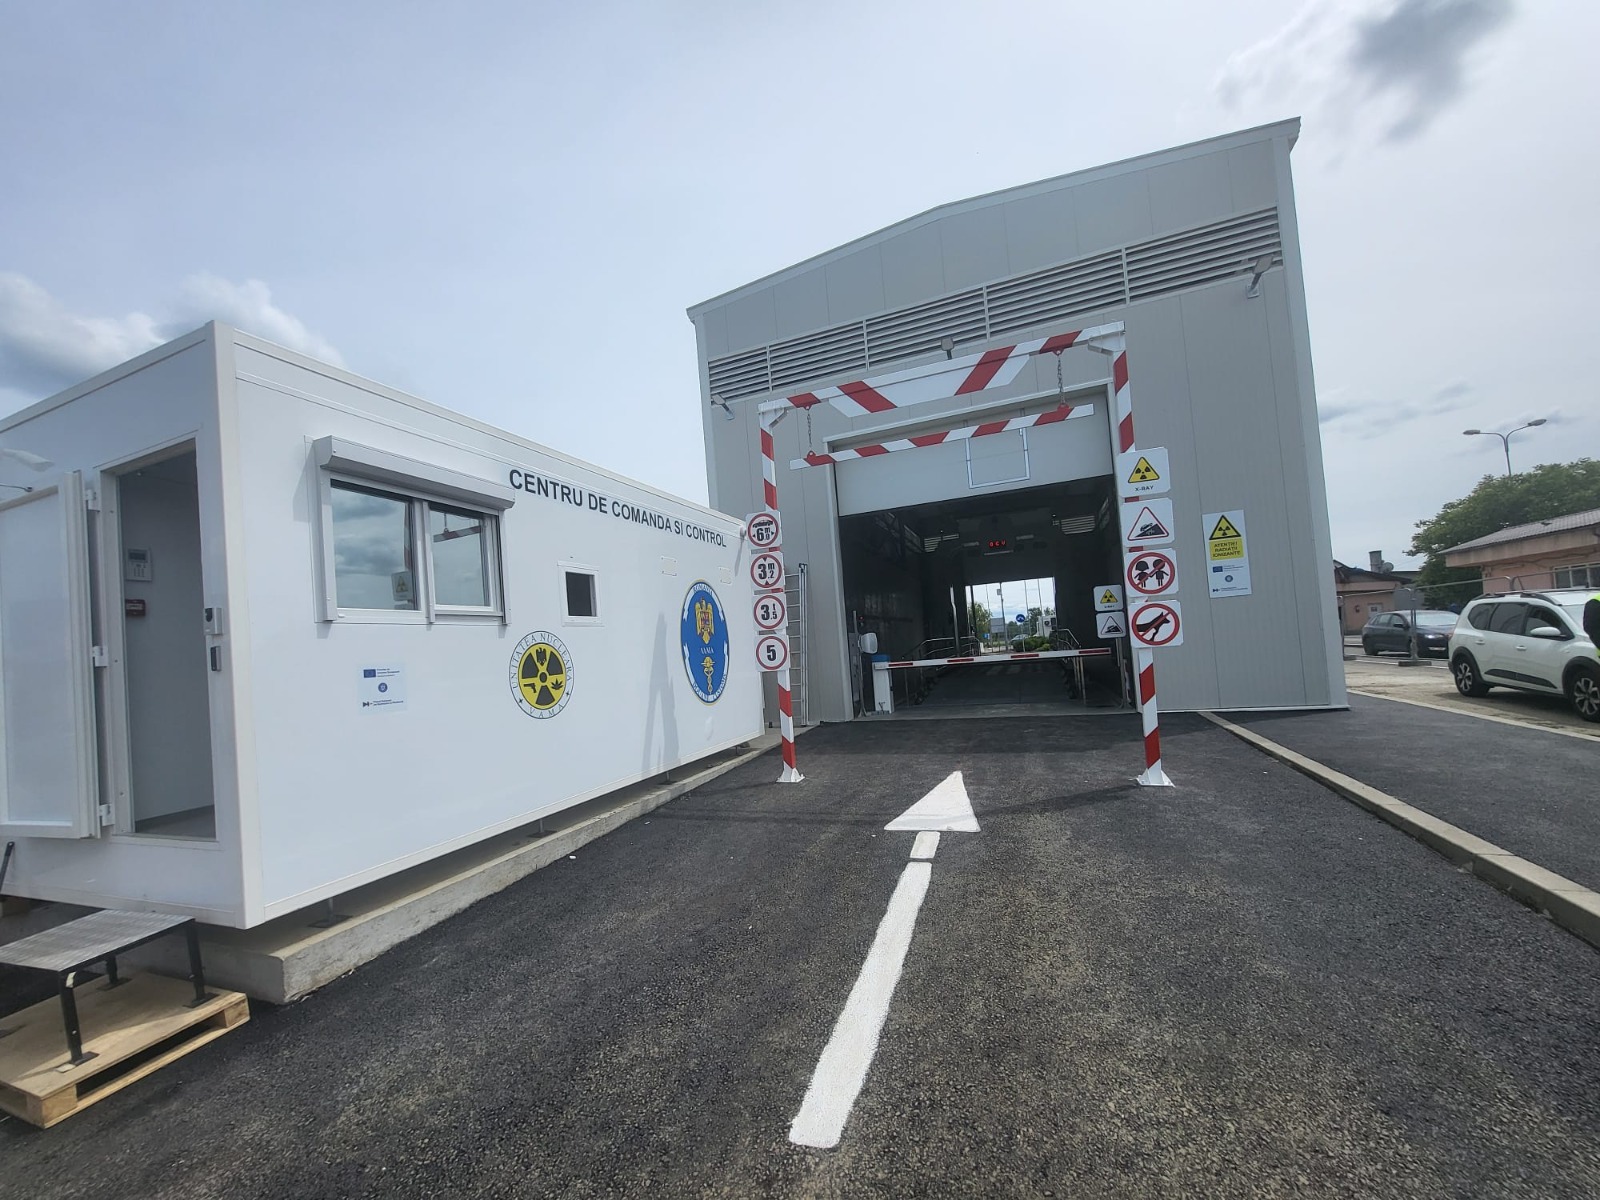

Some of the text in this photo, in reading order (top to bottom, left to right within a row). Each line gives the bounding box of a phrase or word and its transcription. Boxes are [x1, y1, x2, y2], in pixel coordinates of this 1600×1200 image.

[509, 469, 727, 548] CENTRU DE COMANDA SI CONTROL
[766, 644, 777, 662] 5
[529, 703, 564, 719] VAMA
